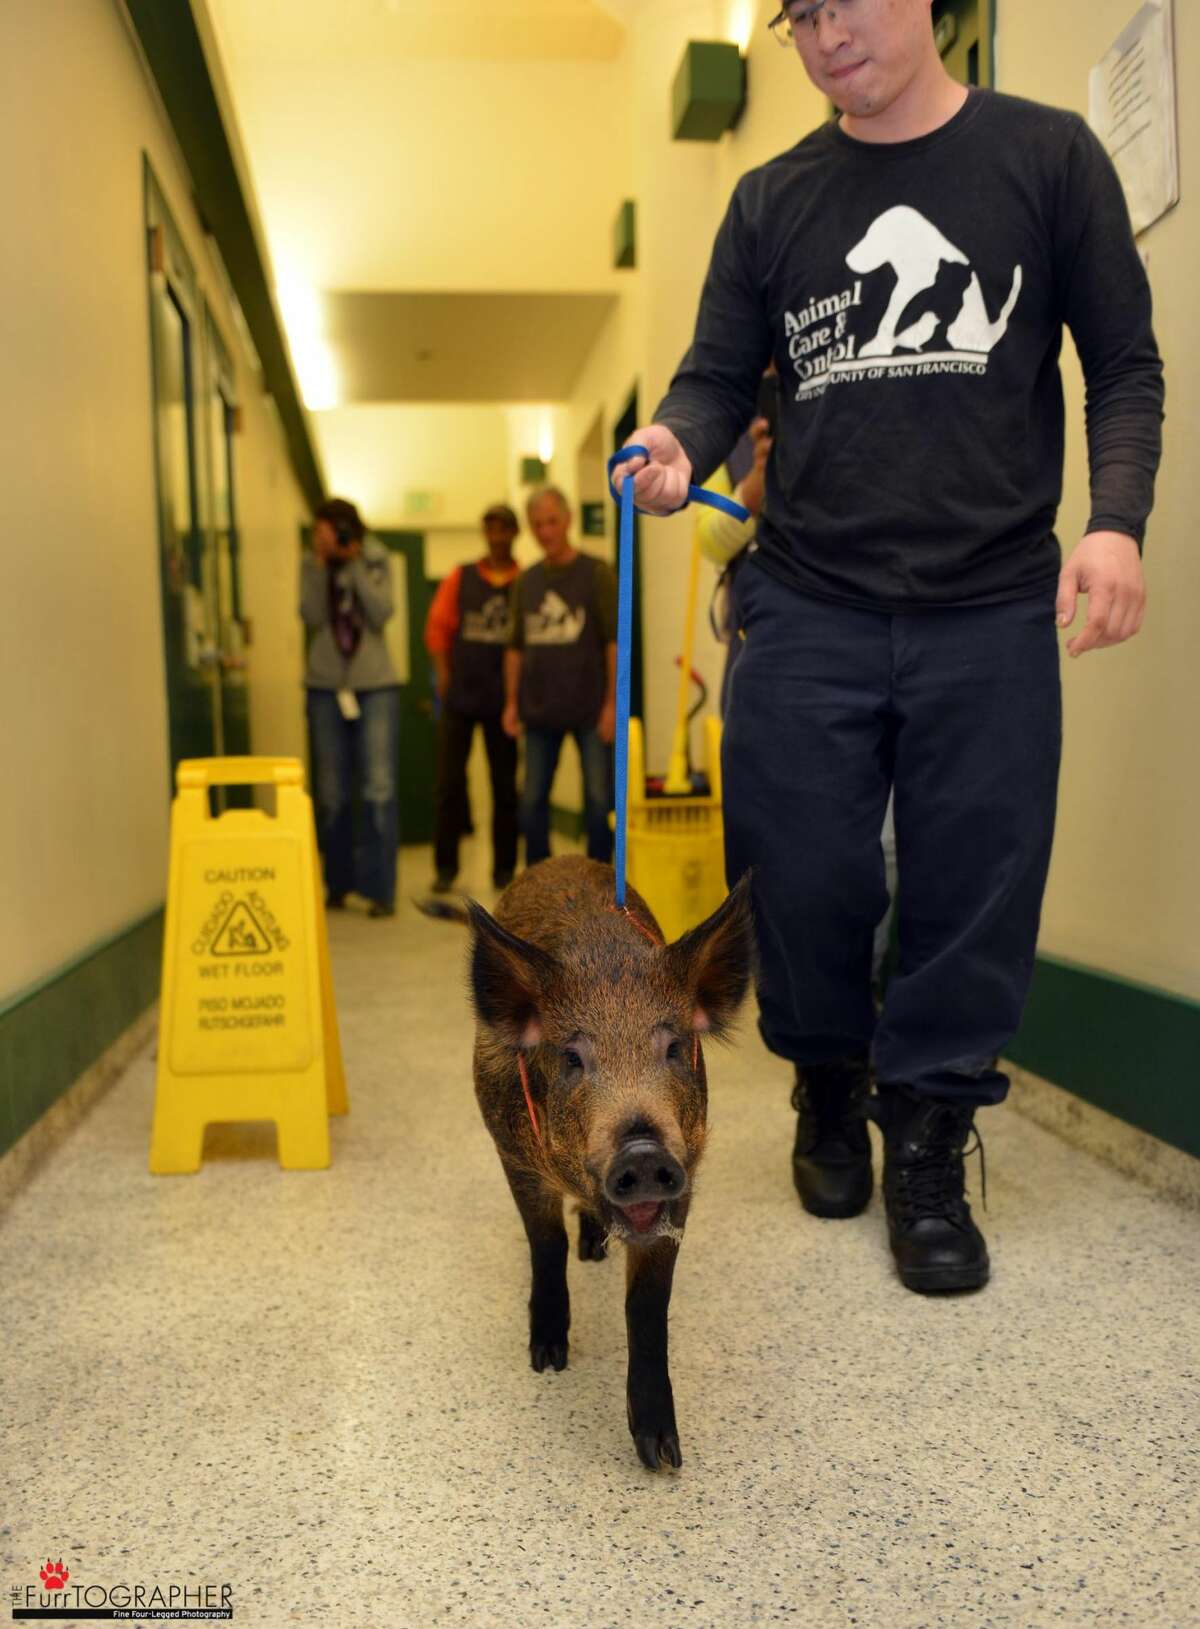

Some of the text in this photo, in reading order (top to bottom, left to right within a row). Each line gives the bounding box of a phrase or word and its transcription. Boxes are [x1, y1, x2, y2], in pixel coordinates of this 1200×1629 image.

[783, 280, 862, 337] Animal
[789, 312, 848, 359] Care &
[867, 365, 886, 380] OF
[887, 364, 914, 378] SAN
[916, 361, 986, 376] FRANCISCO
[204, 866, 275, 884] CAUTION
[198, 960, 284, 979] WET FLOOR
[198, 994, 285, 1012] PISO MOJADO
